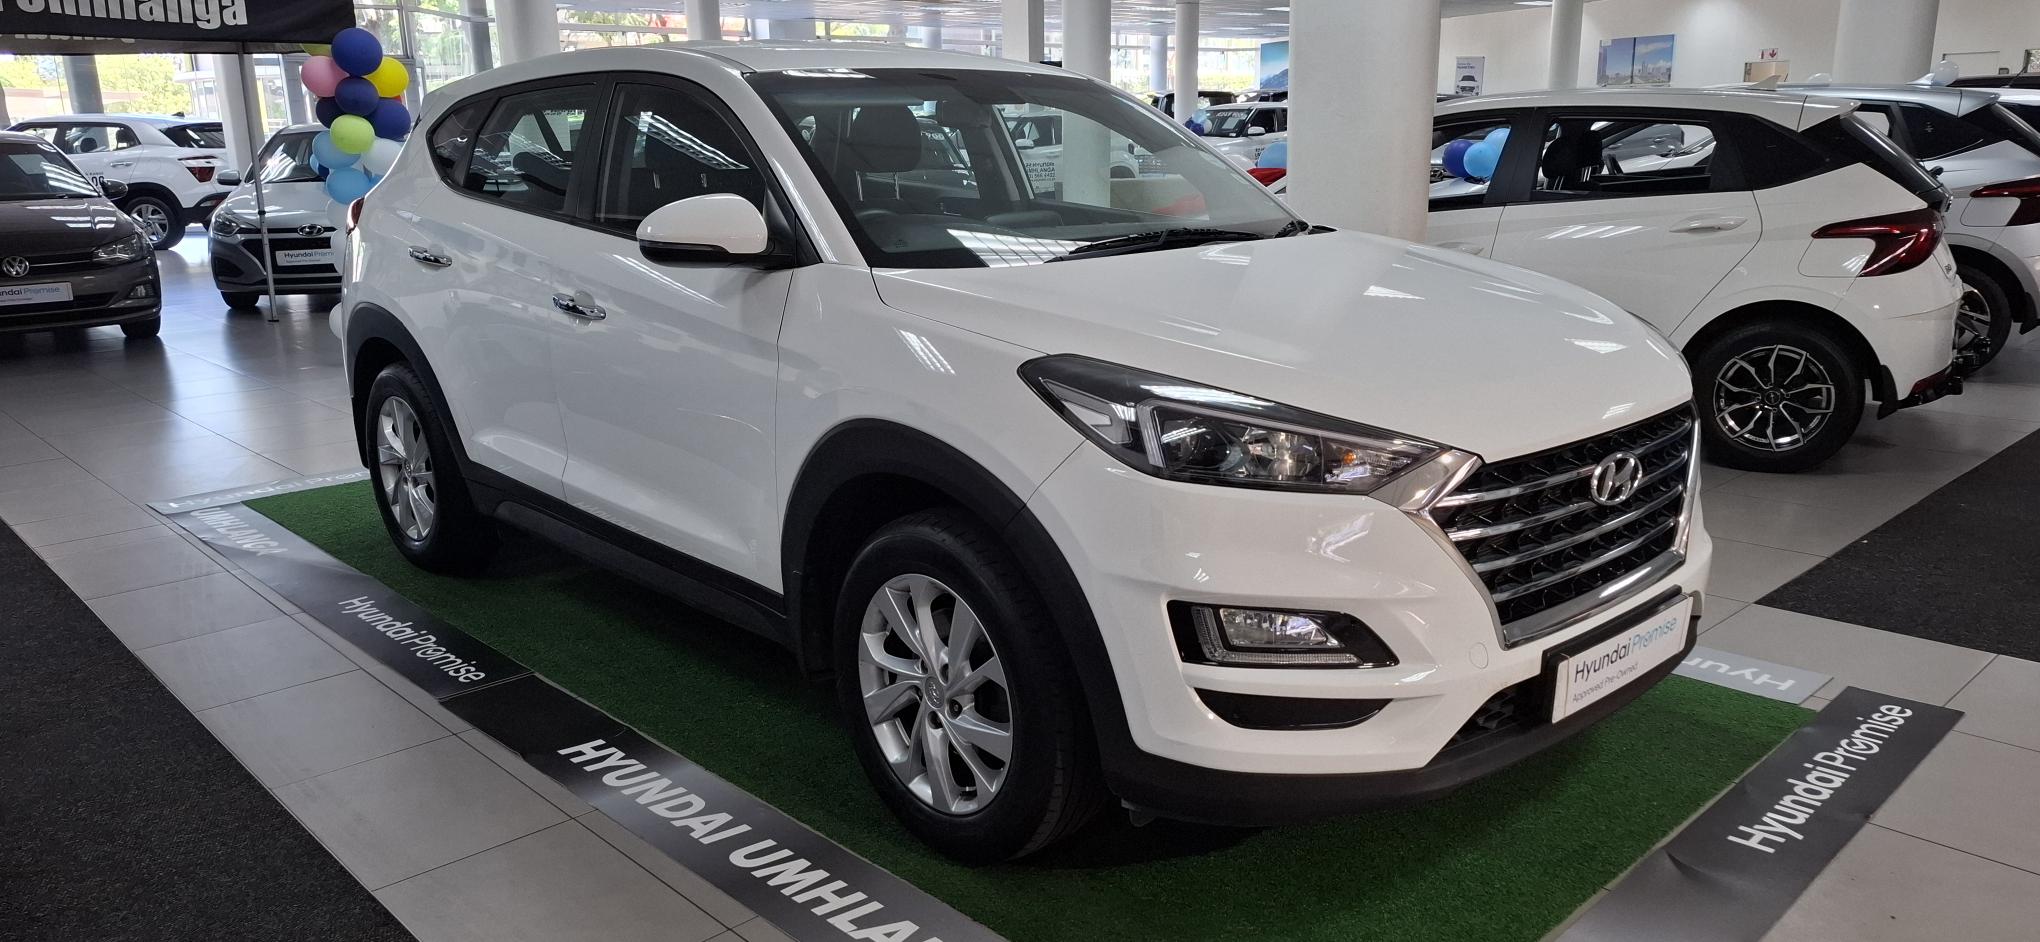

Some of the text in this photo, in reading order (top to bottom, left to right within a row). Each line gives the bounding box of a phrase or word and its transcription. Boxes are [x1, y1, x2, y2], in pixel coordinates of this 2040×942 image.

[189, 507, 288, 556] UMHLANGA
[1572, 661, 1639, 703] Approved Pre-Owned
[556, 739, 943, 942] HYUNDAI UMHLA
